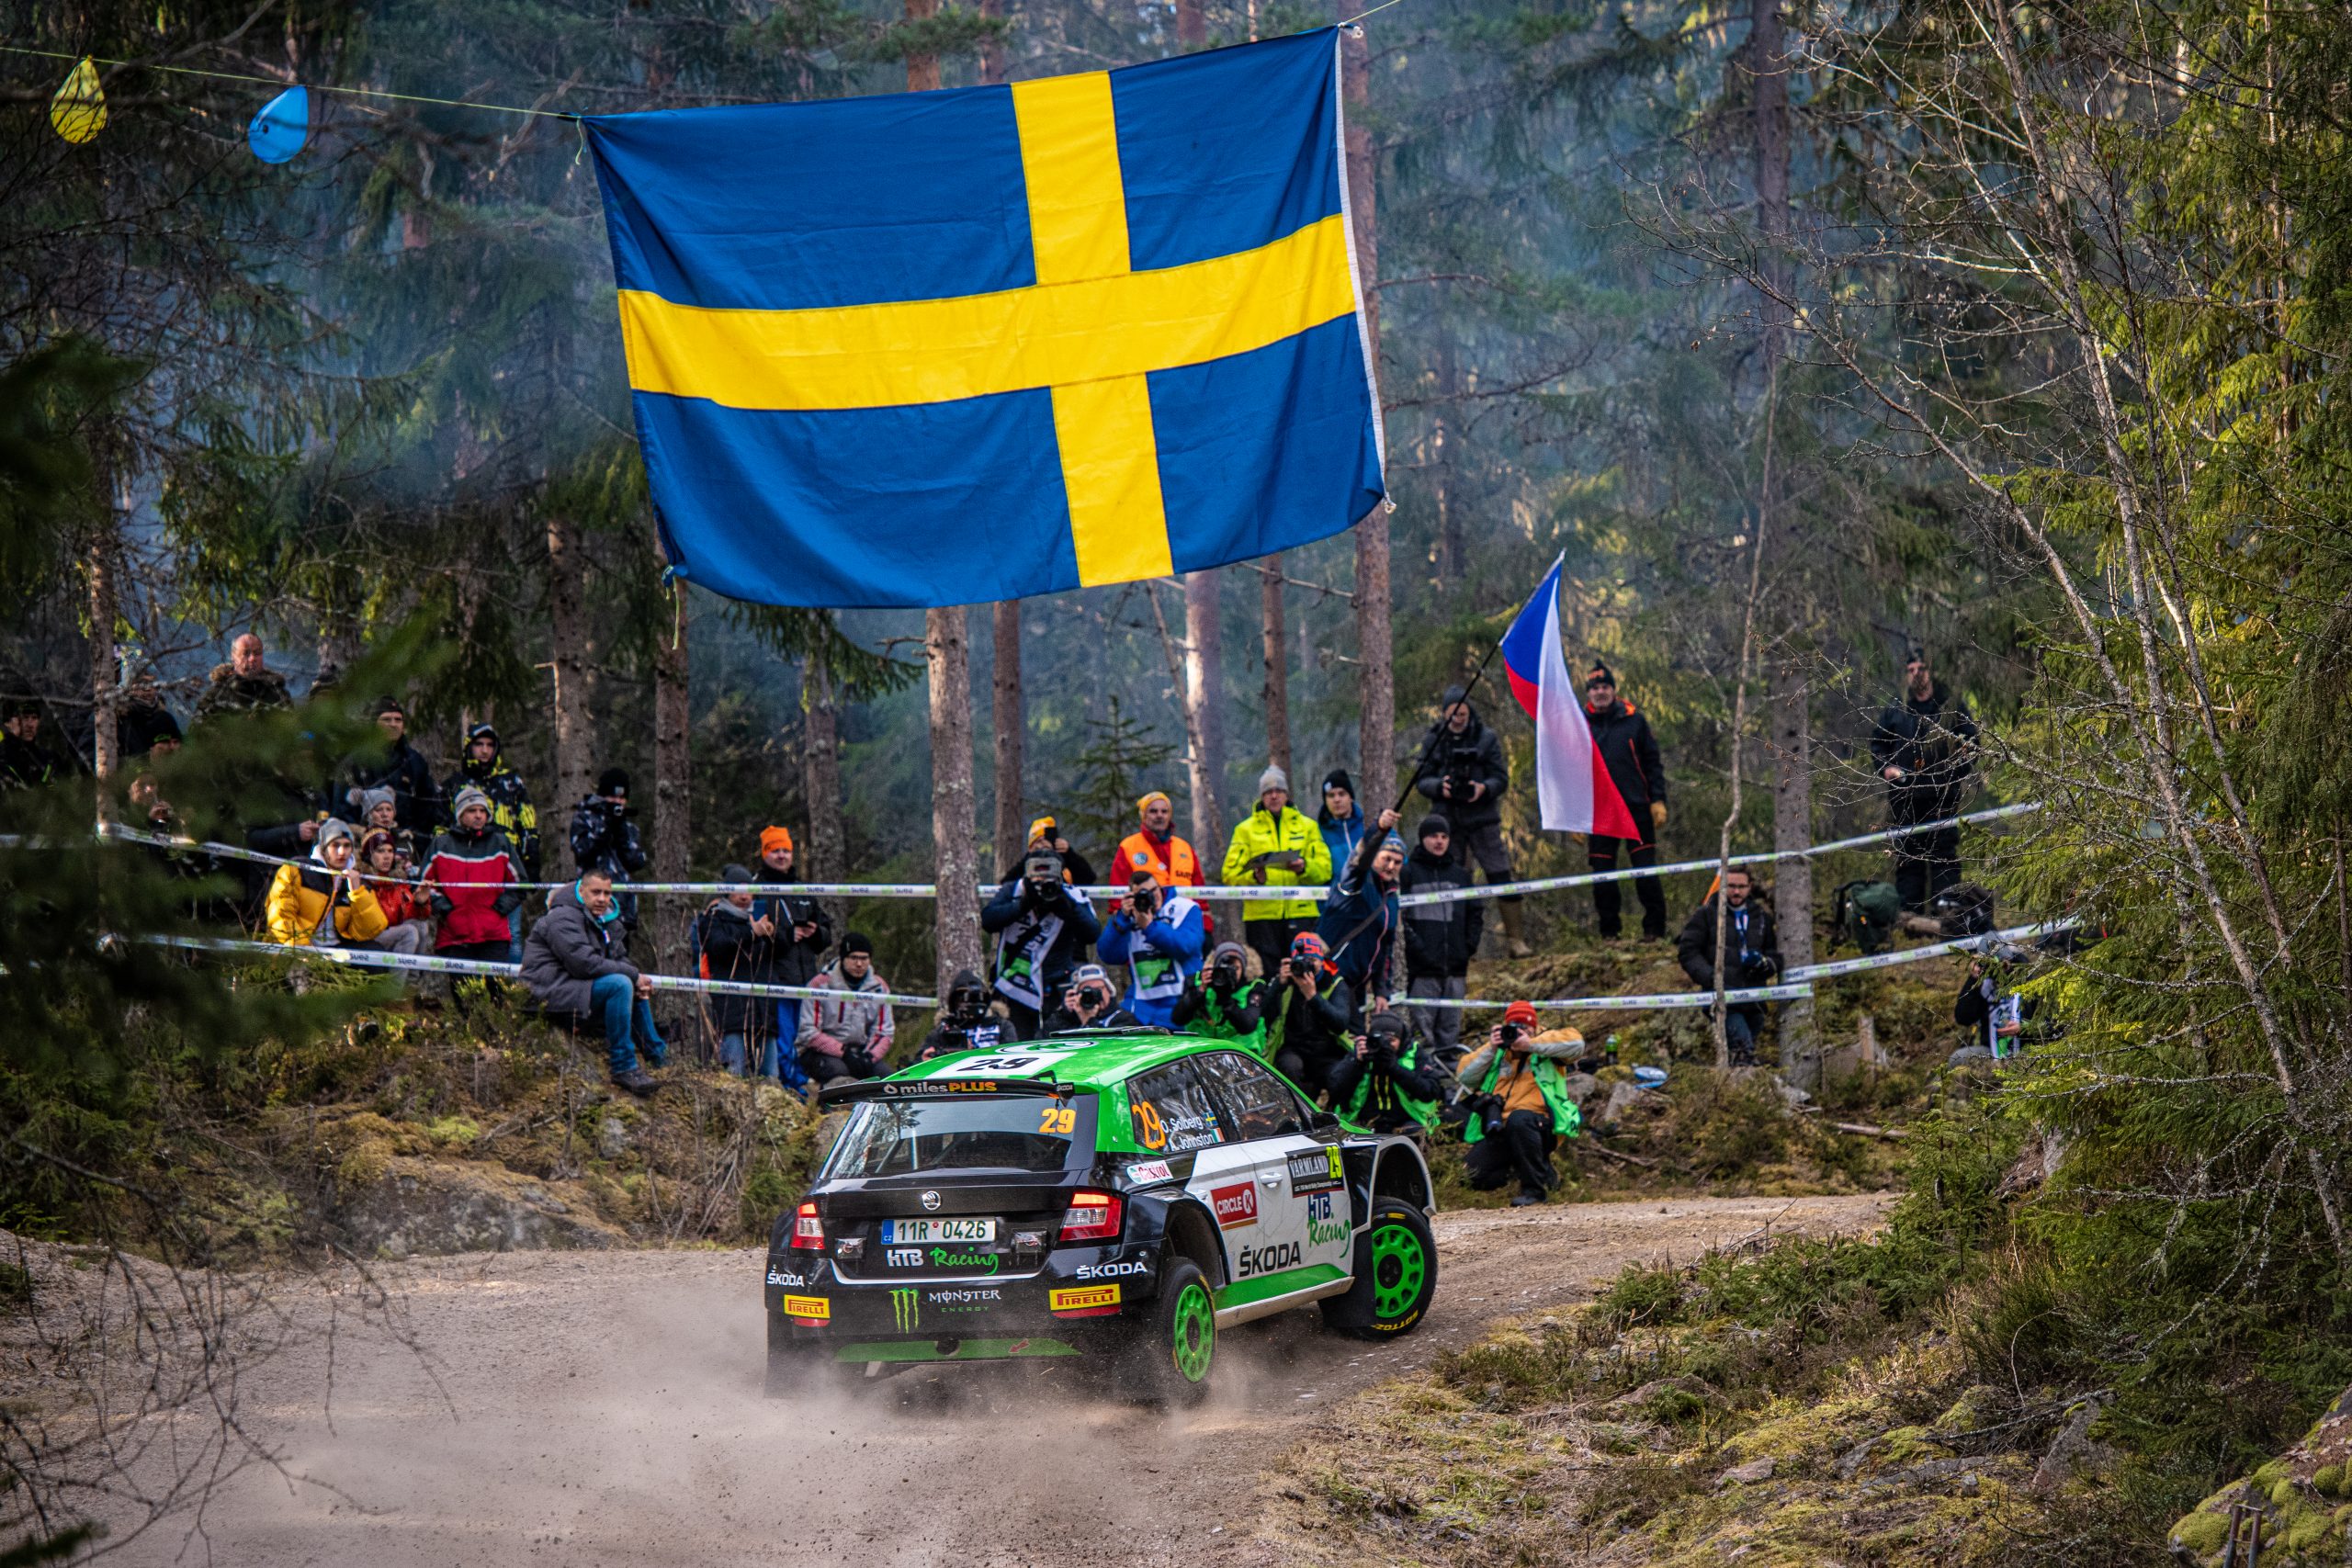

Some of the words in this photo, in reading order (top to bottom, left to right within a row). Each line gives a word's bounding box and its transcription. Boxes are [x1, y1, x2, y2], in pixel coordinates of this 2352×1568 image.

[957, 1057, 1040, 1073] 29
[900, 1081, 998, 1094] milesPLUS
[1039, 1108, 1076, 1134] 29
[1132, 1101, 1166, 1149] 29
[1178, 1133, 1215, 1150] Johnston
[1326, 1145, 1343, 1179] 29
[1216, 1197, 1243, 1216] CIRCLE
[1308, 1192, 1331, 1221] HTB
[899, 1222, 928, 1241] 11R
[942, 1220, 987, 1239] 0426
[1306, 1213, 1351, 1258] Racing
[886, 1249, 924, 1267] HTB
[929, 1247, 999, 1276] Racing
[1239, 1241, 1302, 1278] ŠKODA
[766, 1269, 806, 1288] ŠKODA
[1076, 1261, 1148, 1280] ŠKODA
[787, 1299, 824, 1314] PIRELLI
[1057, 1288, 1114, 1307] PIRELLI
[941, 1305, 990, 1314] ENERGY
